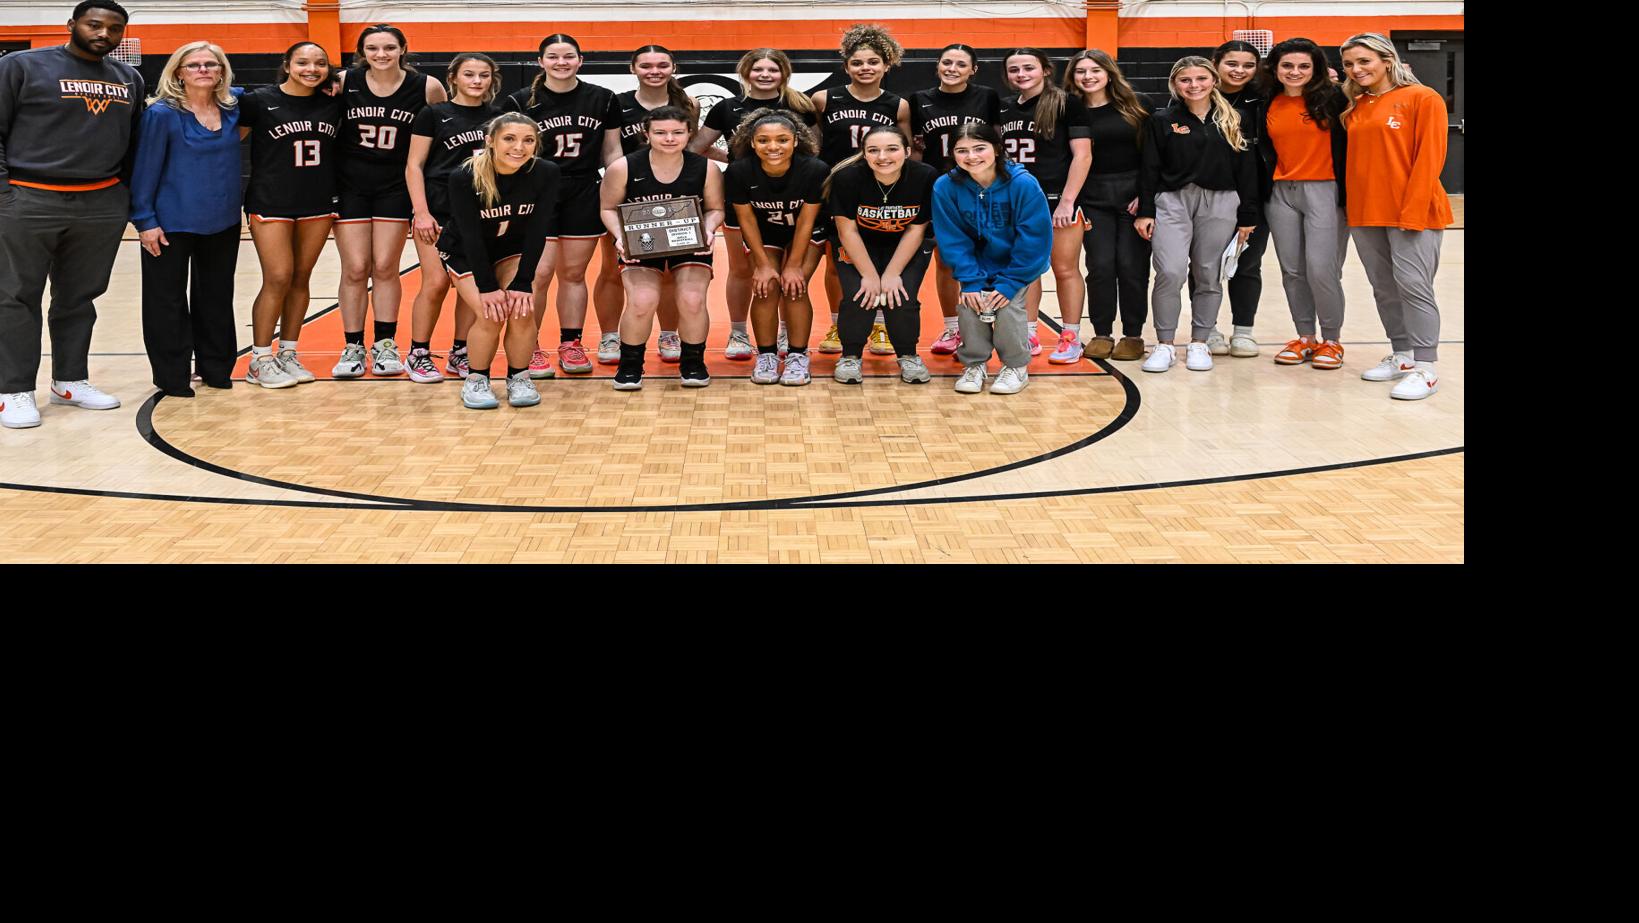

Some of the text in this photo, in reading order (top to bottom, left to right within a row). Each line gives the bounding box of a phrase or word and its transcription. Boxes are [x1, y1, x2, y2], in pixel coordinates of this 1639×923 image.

[60, 81, 103, 95] LENOIR
[105, 85, 129, 98] CITY
[347, 106, 415, 124] LENOIR CITY
[537, 115, 602, 134] ENOIR CITY
[827, 109, 895, 126] LENOIR CITY
[922, 115, 987, 134] LENOIR CIT
[268, 120, 312, 140] LENOIR
[358, 124, 398, 150] 20
[620, 122, 646, 138] LEN
[1000, 120, 1024, 136] ENOIR
[443, 130, 484, 150] LENOIR
[553, 132, 583, 158] 15
[293, 139, 321, 167] 13
[1004, 138, 1036, 163] 22
[480, 204, 512, 219] NOIR
